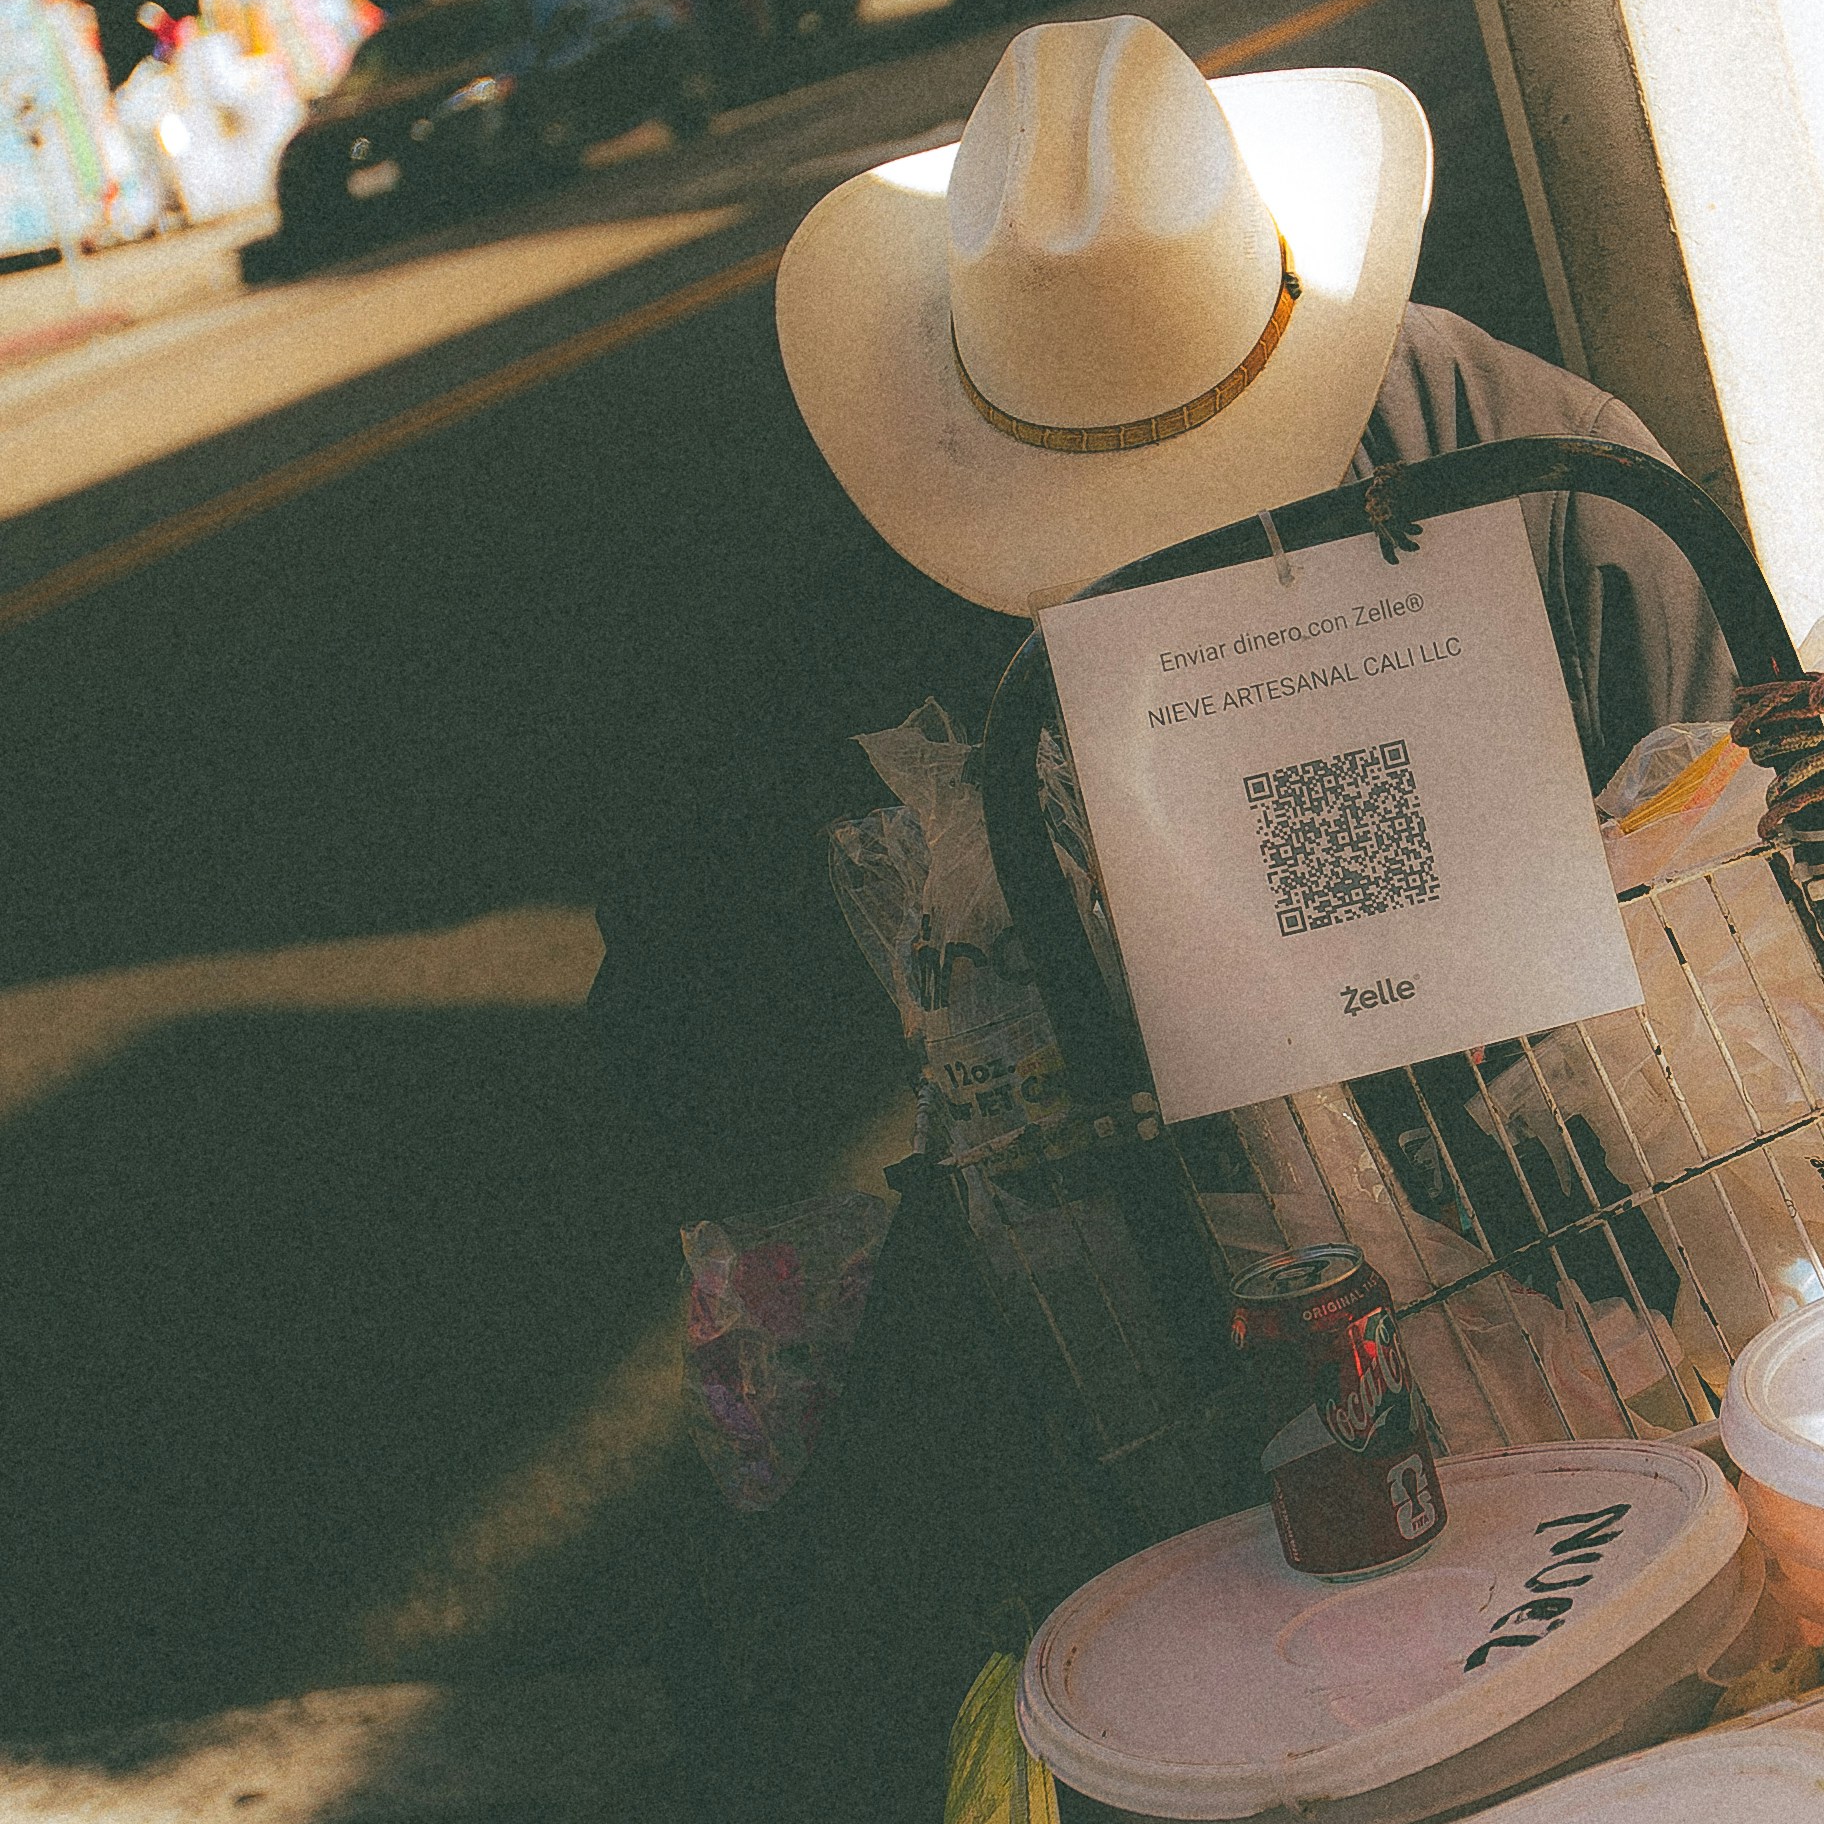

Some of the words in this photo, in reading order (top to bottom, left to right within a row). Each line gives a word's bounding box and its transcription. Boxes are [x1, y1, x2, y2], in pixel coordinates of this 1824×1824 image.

[1159, 642, 1227, 674] Enviar
[1232, 624, 1302, 657] dinero
[1302, 611, 1348, 638] con
[1148, 695, 1218, 730] NIEVE
[1221, 661, 1359, 712] ARTESANAL
[1362, 647, 1417, 679] CALI
[1419, 635, 1463, 665] LLC
[1302, 1288, 1365, 1323] ORIGINAL
